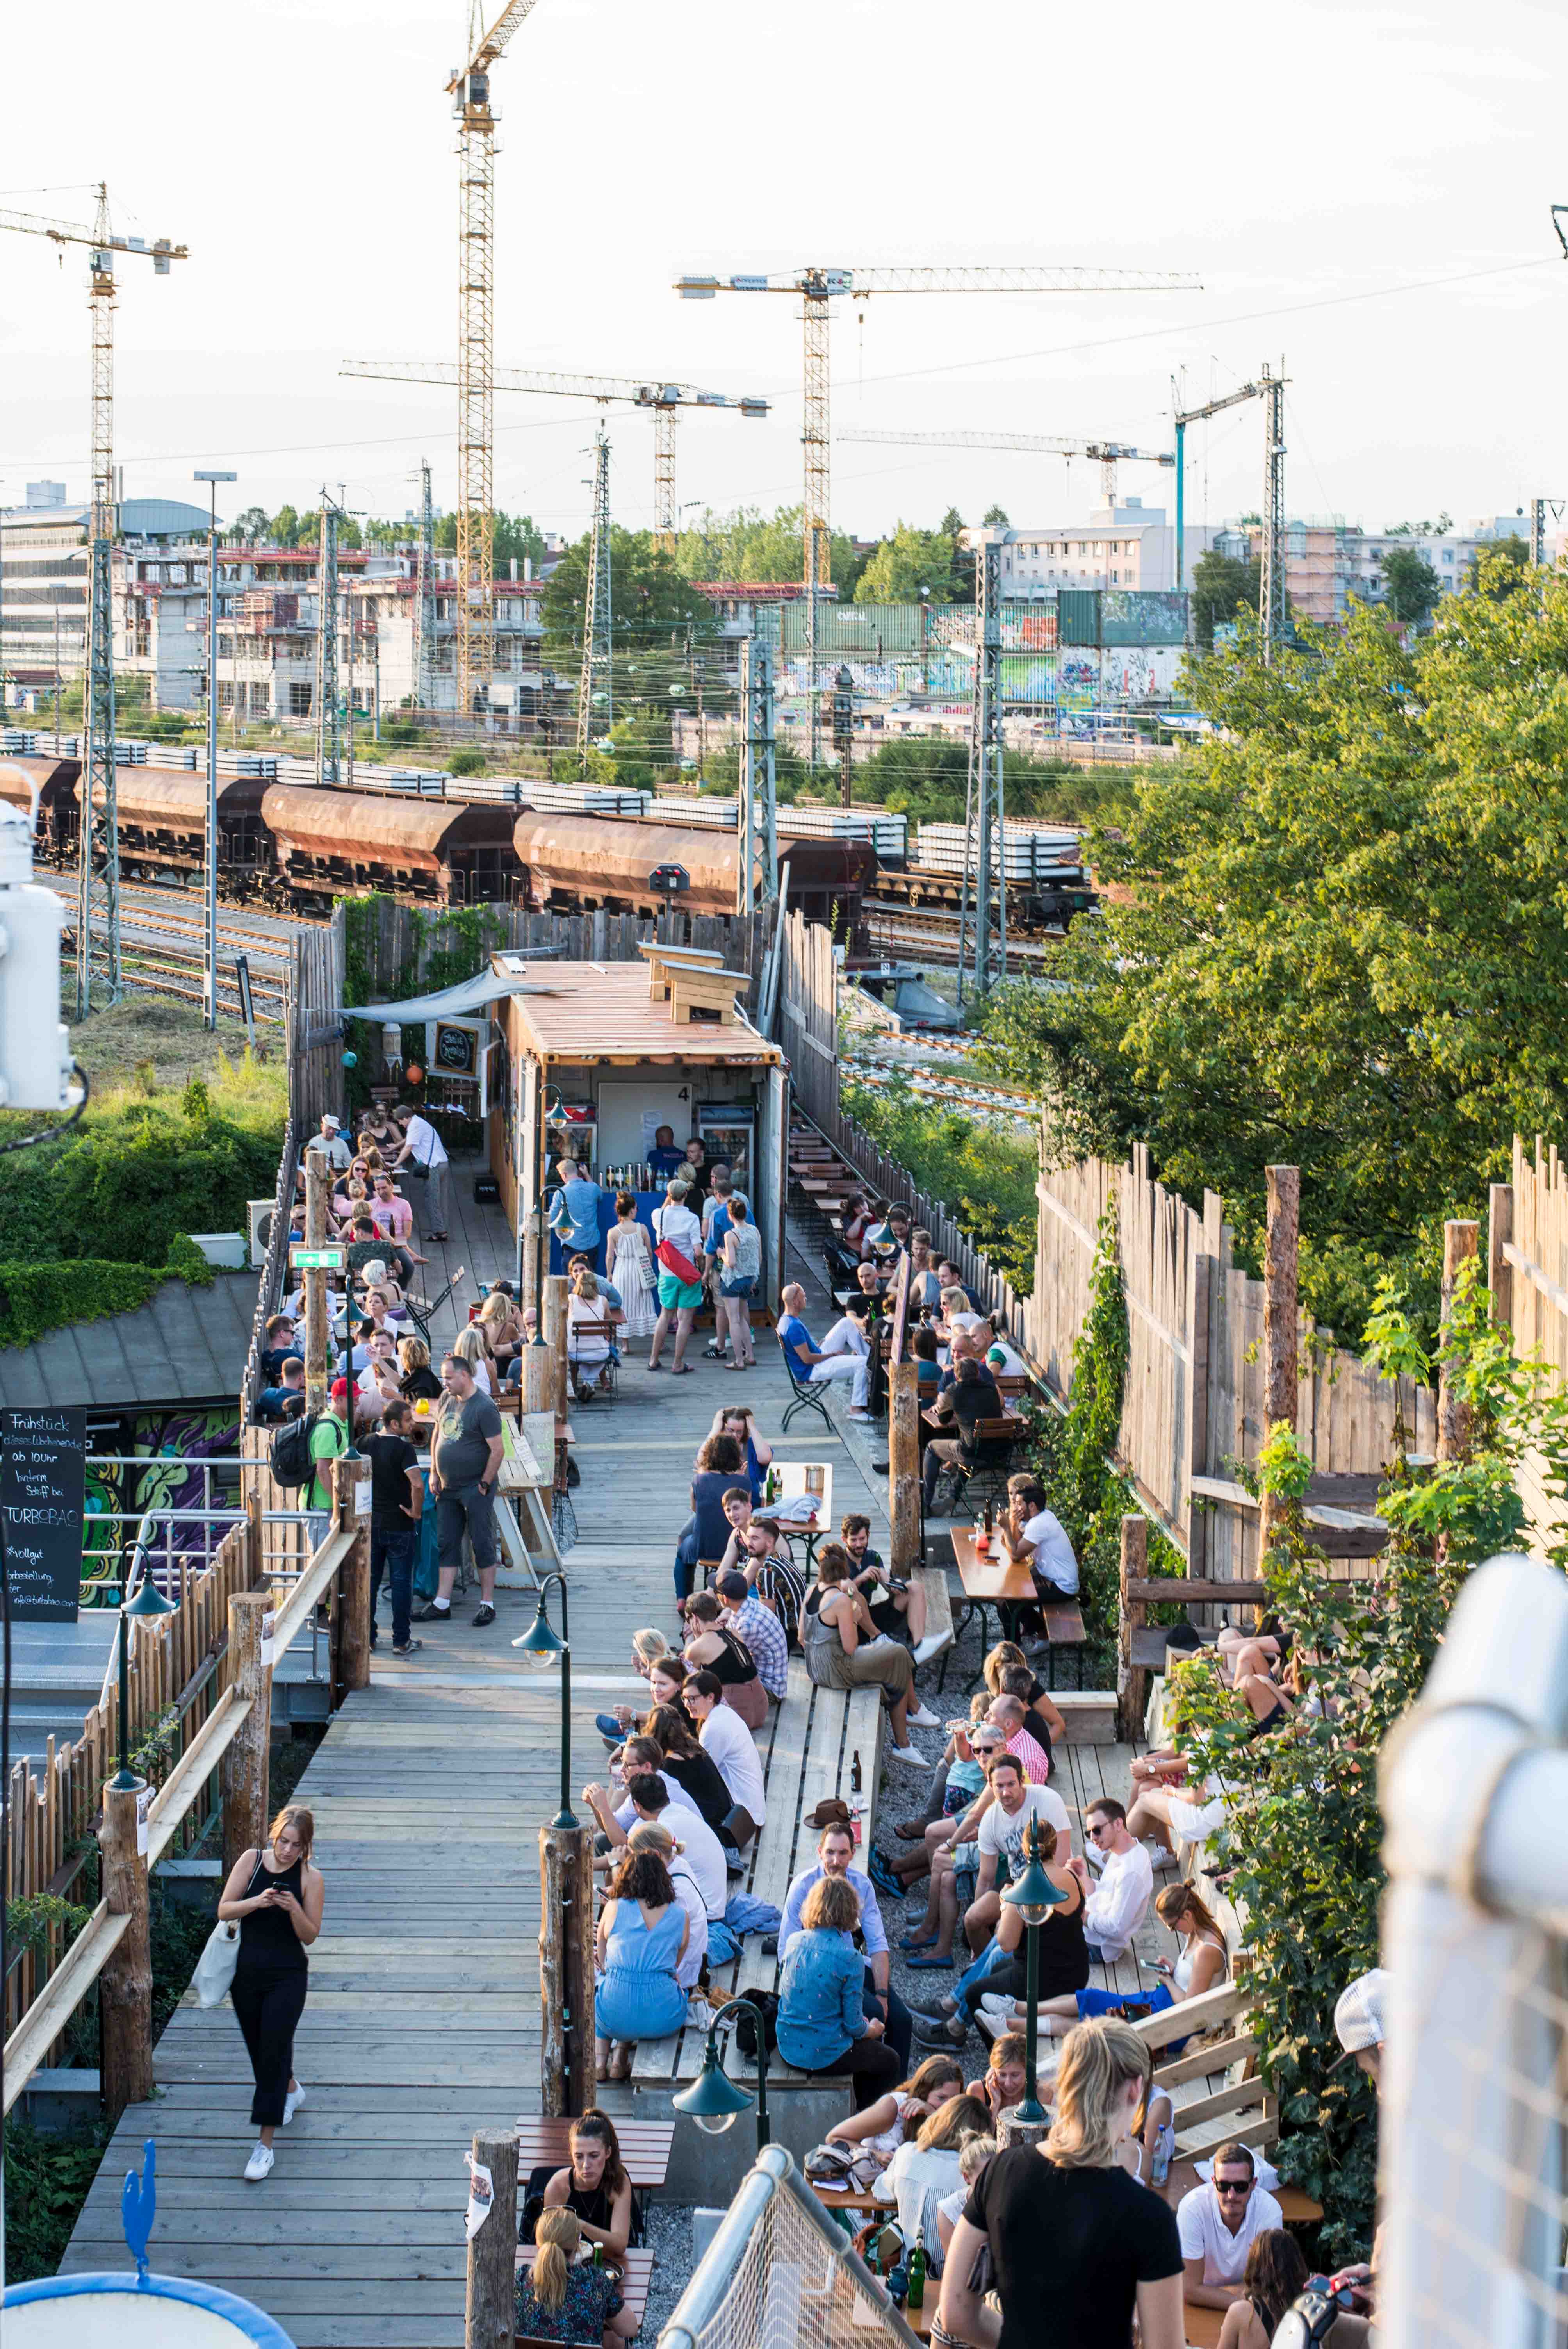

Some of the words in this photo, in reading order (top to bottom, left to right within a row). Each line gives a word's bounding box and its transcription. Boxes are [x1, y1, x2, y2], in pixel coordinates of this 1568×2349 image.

[678, 1087, 690, 1101] 4
[9, 1413, 69, 1432] Frühstück
[12, 1450, 25, 1461] ab
[15, 1469, 47, 1482] hinterm
[26, 1485, 49, 1499] Schiff
[52, 1486, 64, 1496] bei
[3, 1506, 78, 1527] TURBOBAO
[7, 1569, 55, 1589] orbestellung
